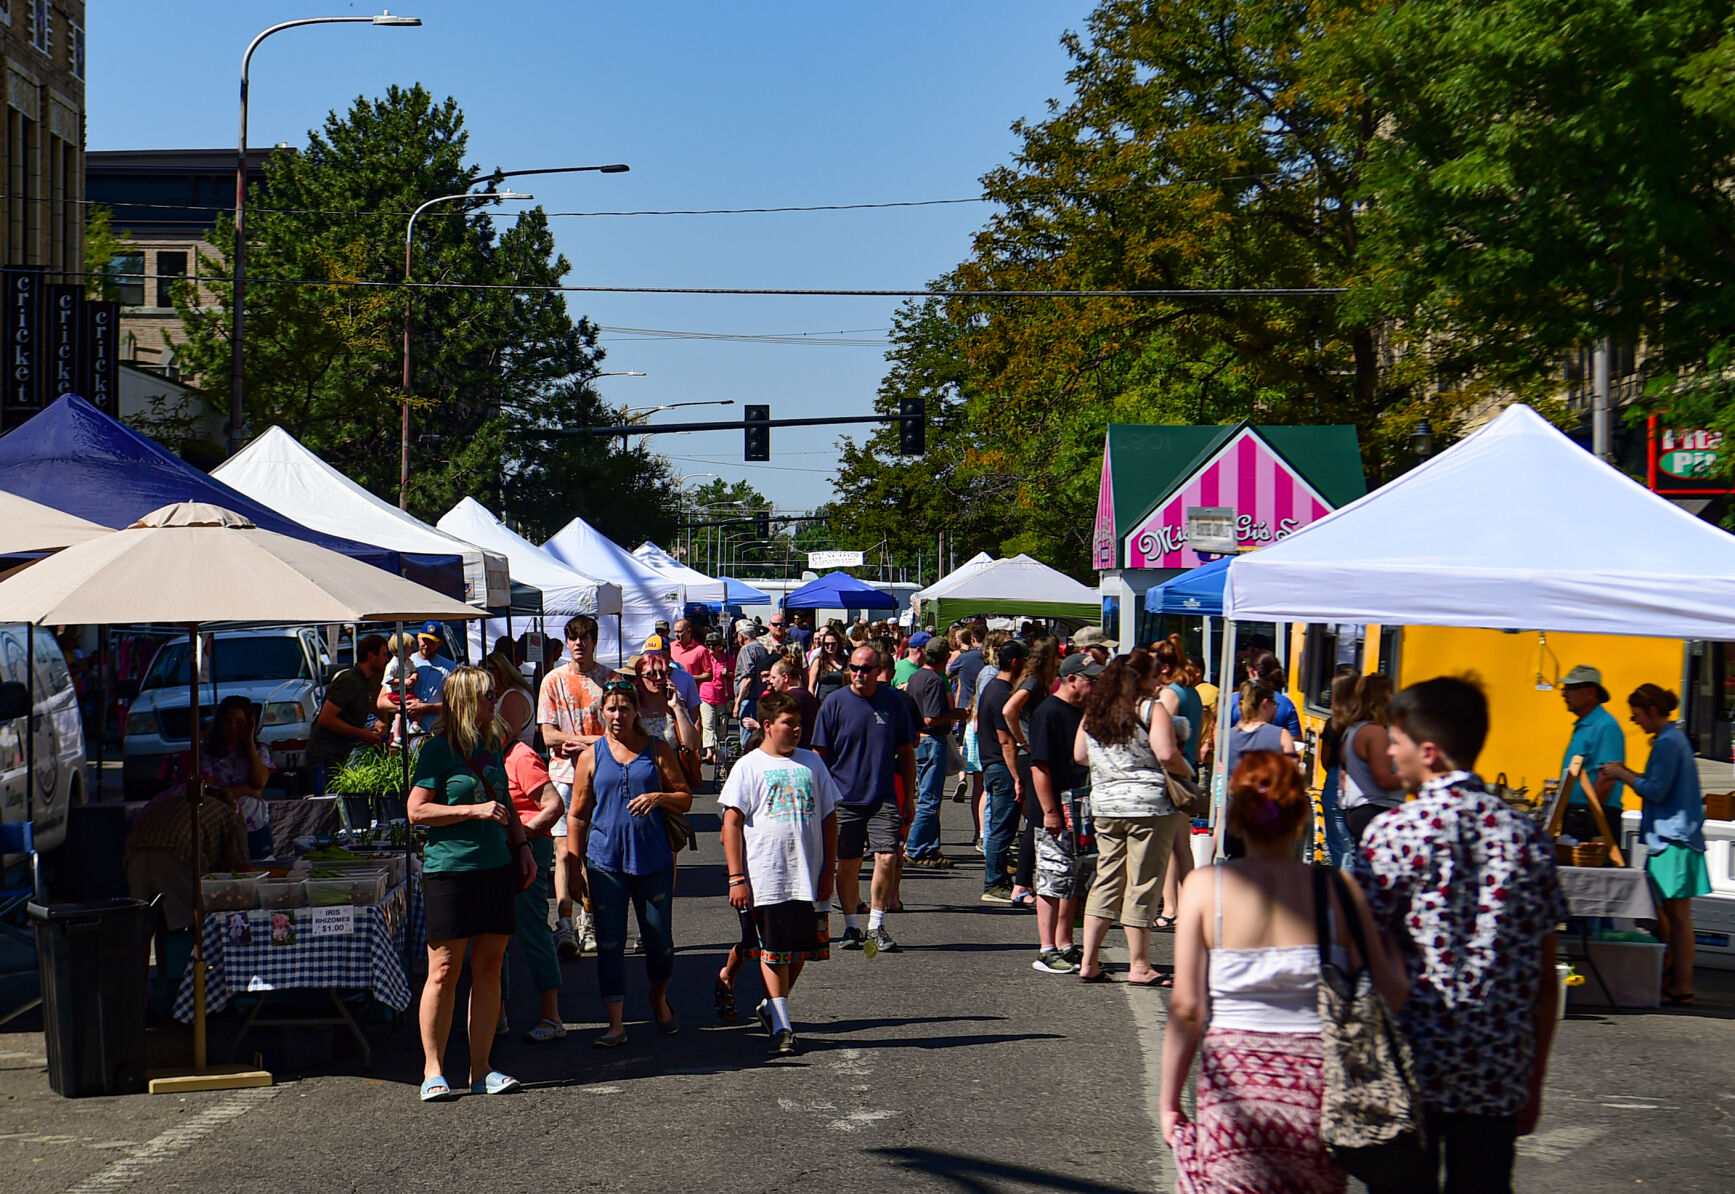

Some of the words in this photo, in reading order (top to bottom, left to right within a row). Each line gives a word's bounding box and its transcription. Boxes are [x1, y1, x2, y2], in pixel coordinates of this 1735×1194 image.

[15, 276, 31, 403] cricket
[57, 294, 71, 393] cricke
[95, 310, 108, 407] cricke
[1235, 514, 1272, 542] Gi's
[763, 769, 790, 779] SPACE
[792, 768, 811, 778] JAM
[315, 916, 350, 924] RHIZOMES
[322, 924, 344, 932] $1.00
